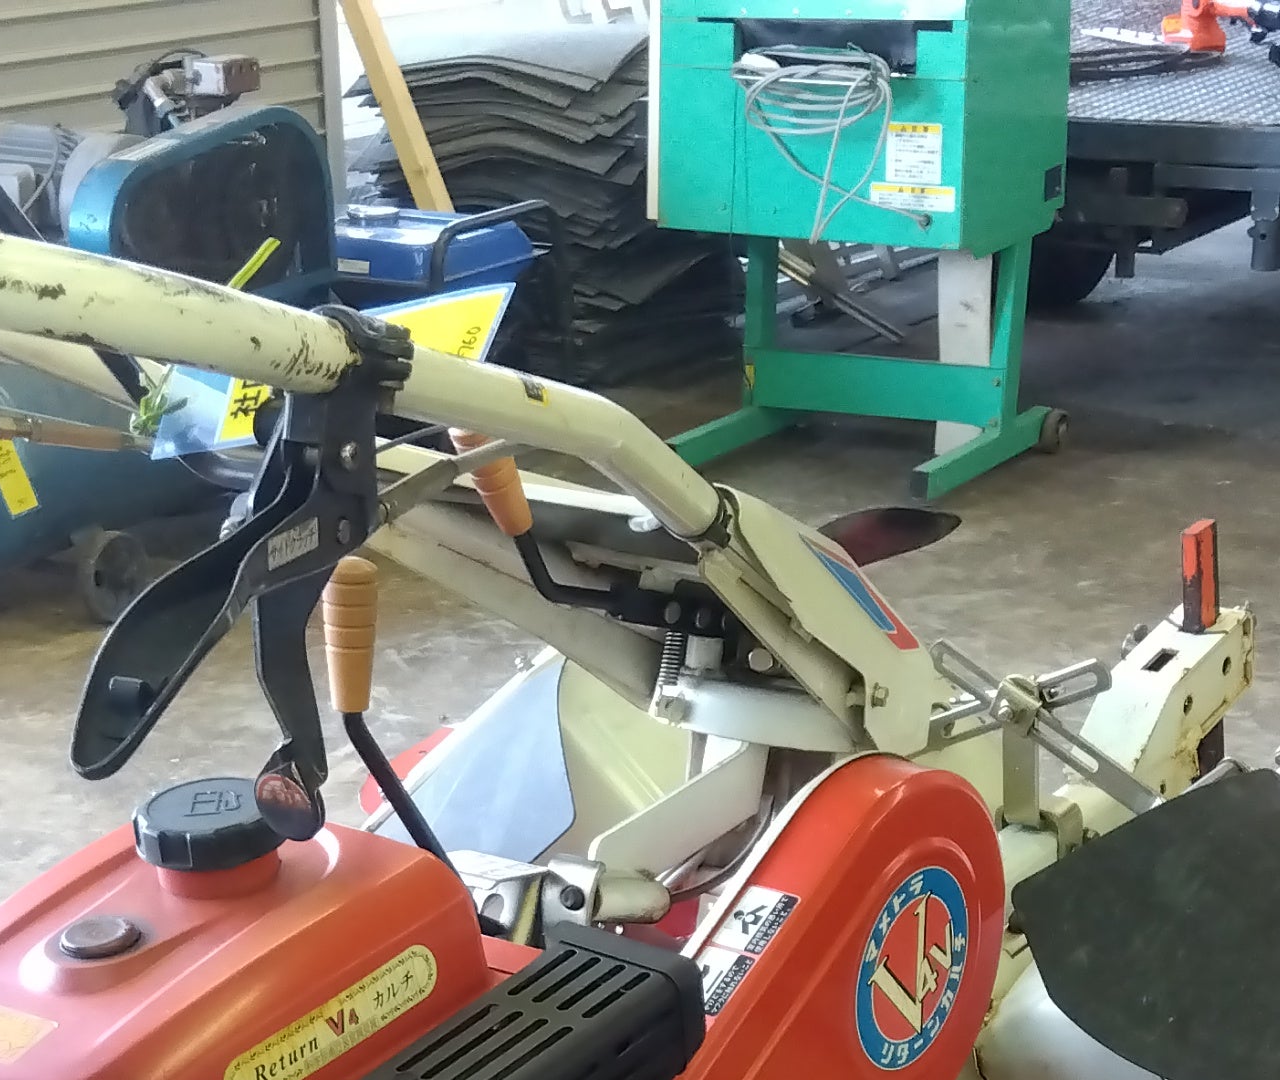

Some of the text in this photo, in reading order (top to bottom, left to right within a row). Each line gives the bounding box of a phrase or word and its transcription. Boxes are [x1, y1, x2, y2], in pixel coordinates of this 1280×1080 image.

[864, 873, 925, 963] マメトラ
[325, 1008, 360, 1037] V4
[372, 970, 415, 1011] カルチ
[880, 932, 967, 1066] リターンカルチ
